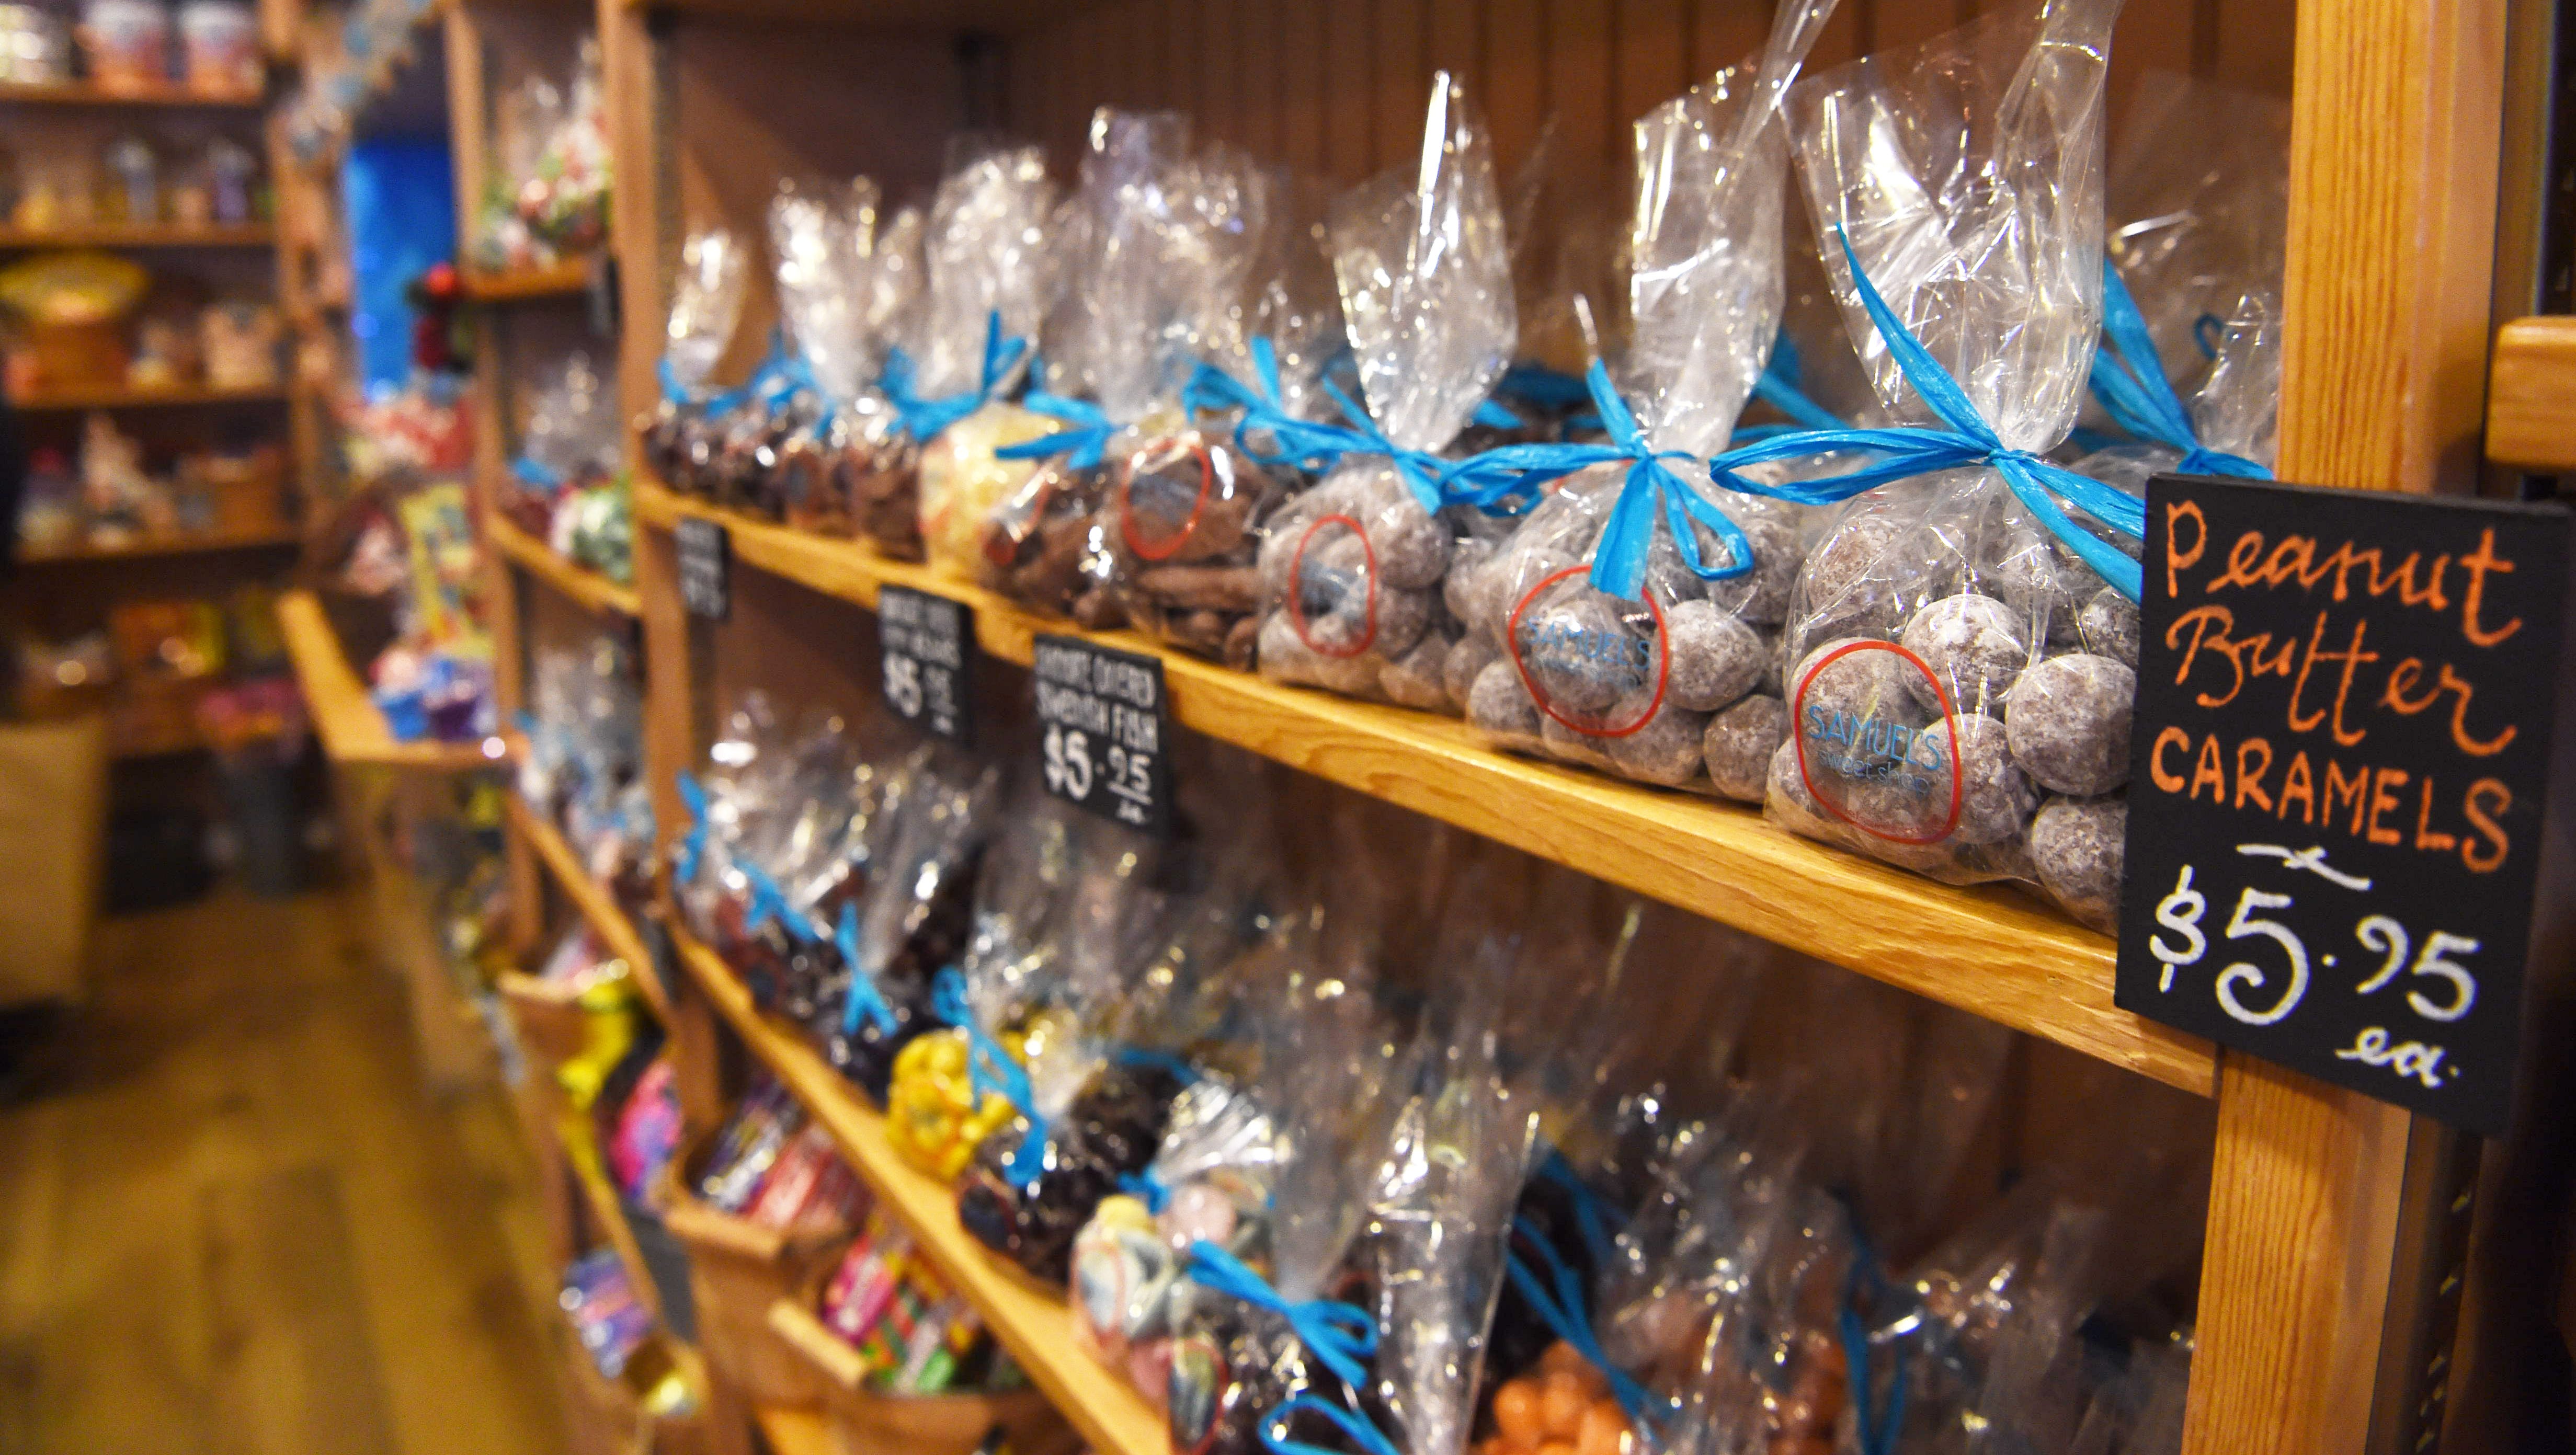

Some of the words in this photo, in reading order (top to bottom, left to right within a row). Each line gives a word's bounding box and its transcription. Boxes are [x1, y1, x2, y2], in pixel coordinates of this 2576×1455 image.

[2165, 499, 2522, 647] Peanut
[1808, 704, 1942, 771] SAMUEL'S
[2164, 604, 2517, 757] Butter
[2149, 725, 2512, 872] CARAMELS
